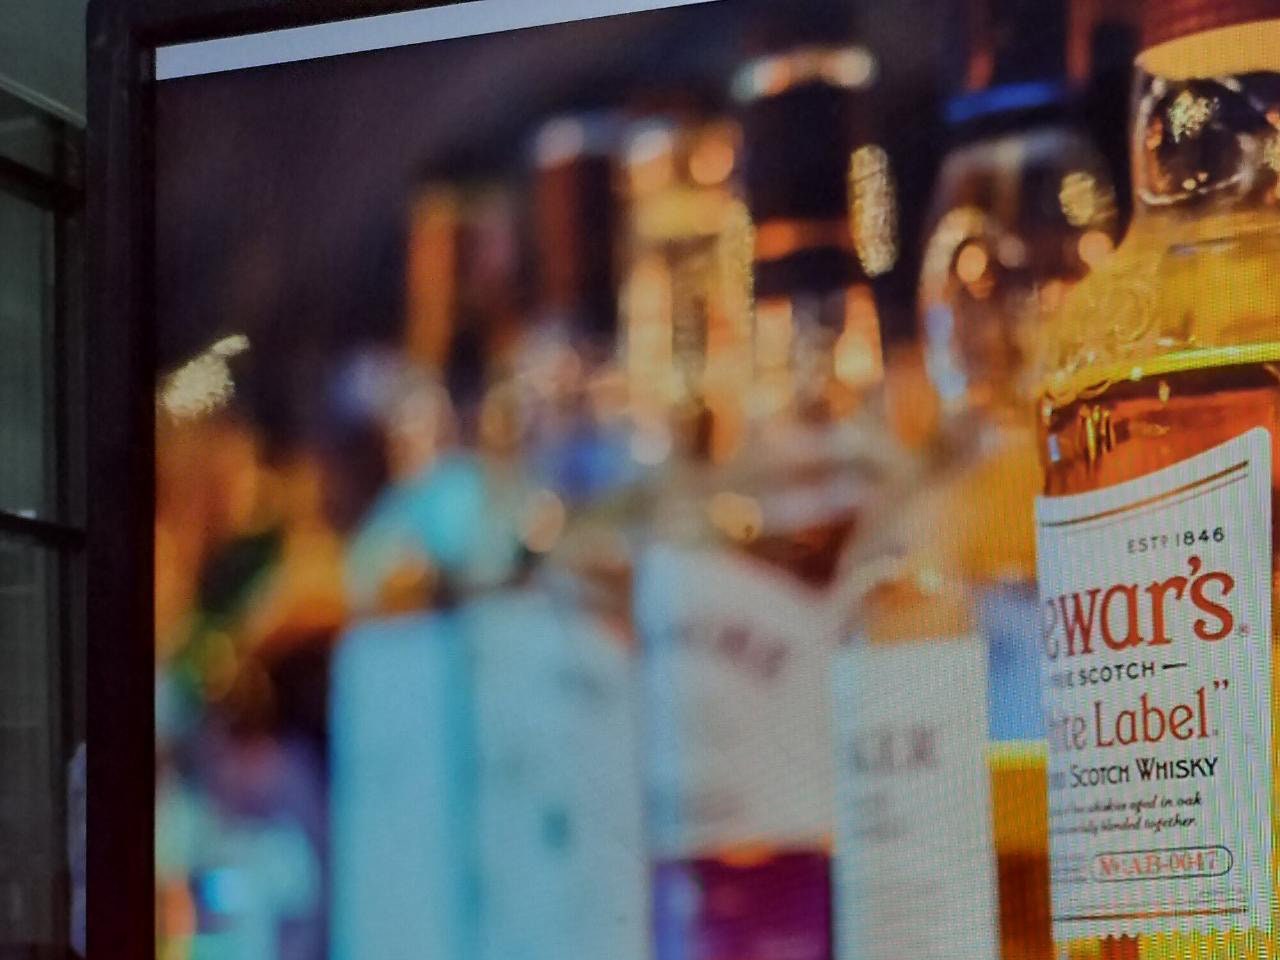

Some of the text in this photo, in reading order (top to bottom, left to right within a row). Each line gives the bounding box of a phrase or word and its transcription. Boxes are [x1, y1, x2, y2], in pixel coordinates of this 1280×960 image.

[1176, 526, 1226, 549] 1846
[1079, 661, 1156, 688] SCOTCH
[1136, 756, 1219, 781] WHISKY
